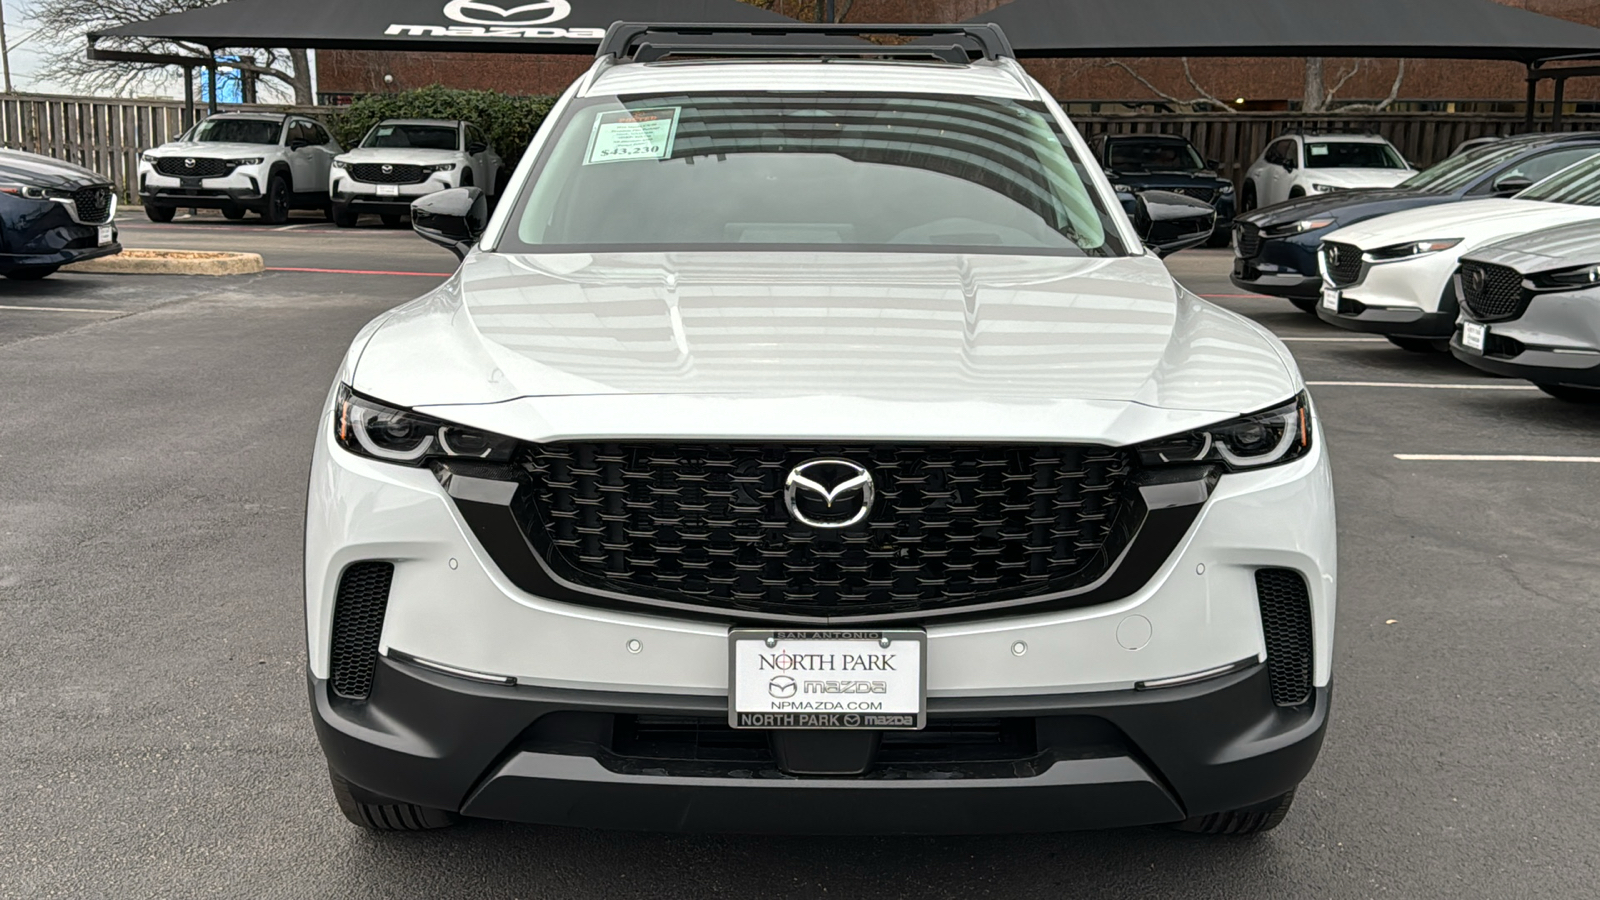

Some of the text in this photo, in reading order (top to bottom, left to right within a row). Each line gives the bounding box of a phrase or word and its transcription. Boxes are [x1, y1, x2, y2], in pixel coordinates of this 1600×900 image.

[384, 23, 606, 39] mazda
[600, 146, 659, 156] $43,230
[758, 653, 897, 671] NORTH PARK
[803, 680, 887, 694] mazda
[771, 701, 882, 710] NPMAZDA.COM
[741, 714, 913, 726] NORTH PARK mazda
